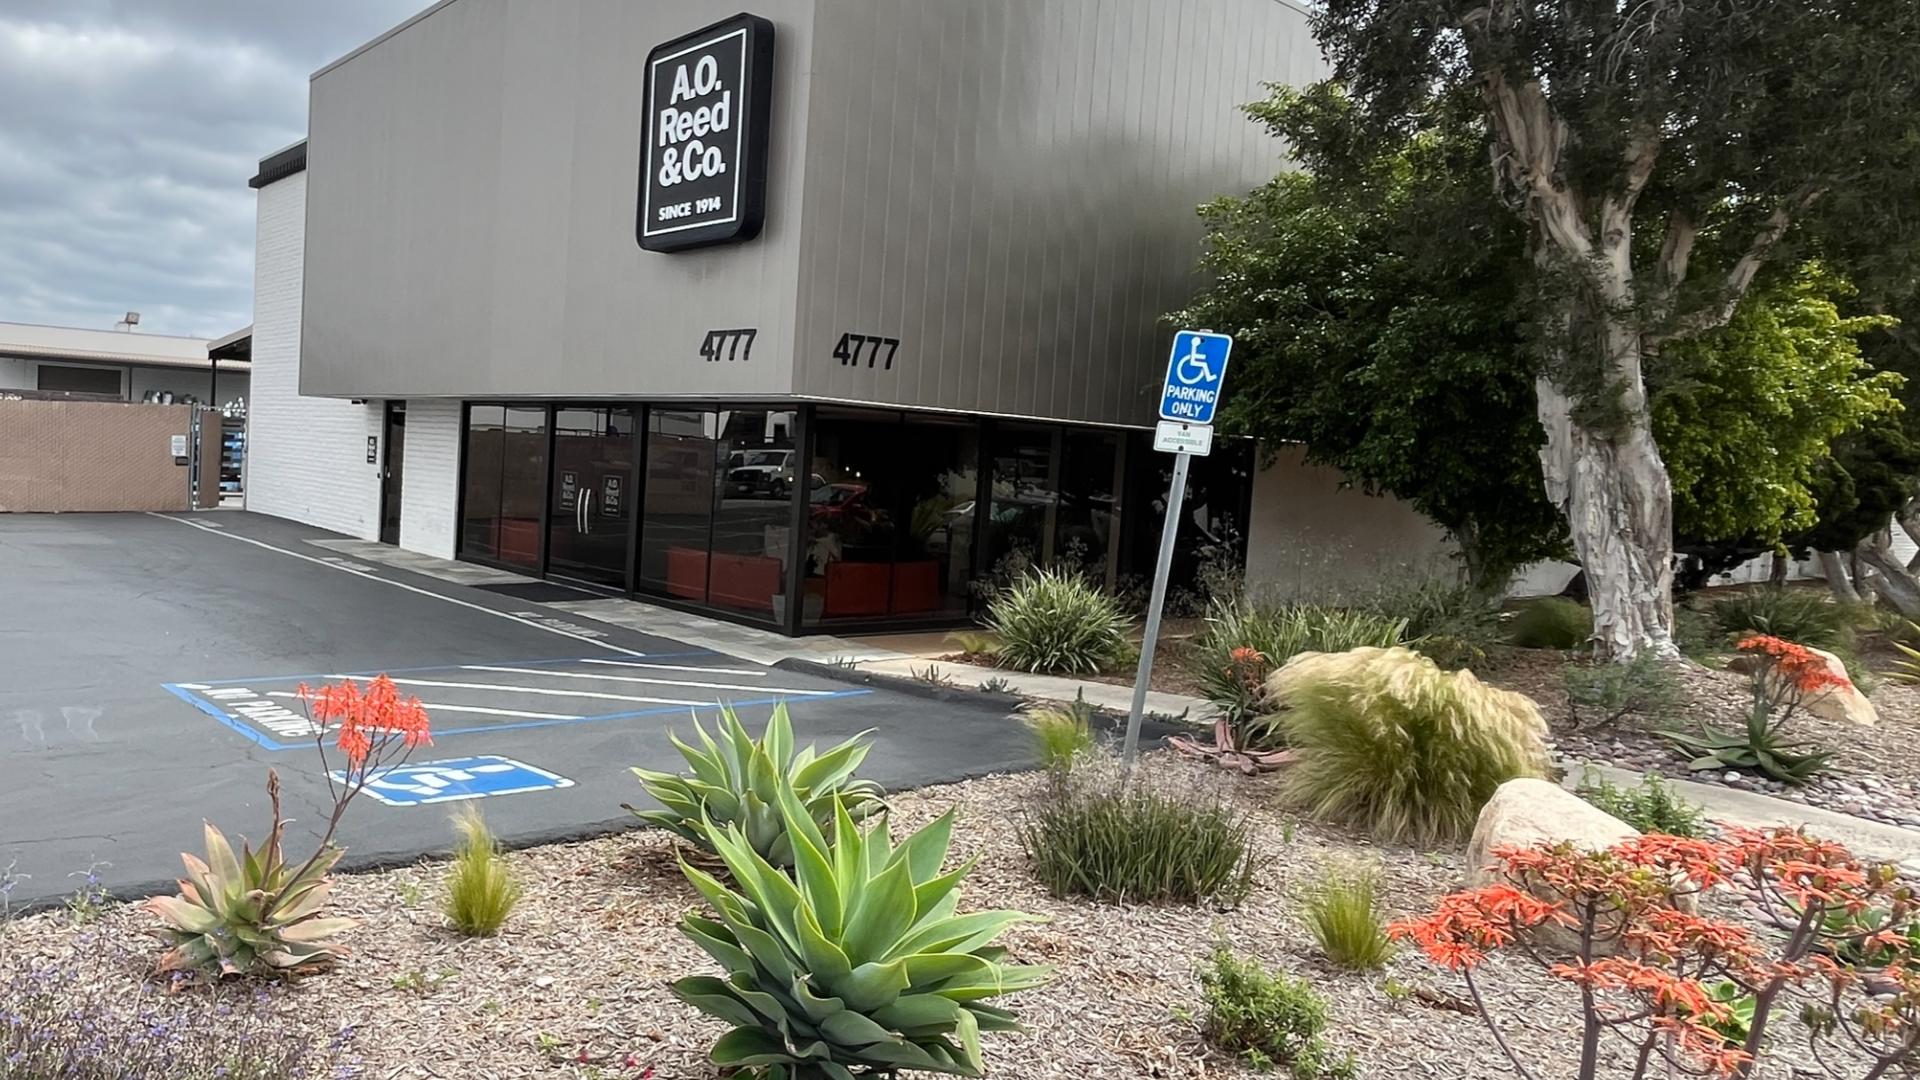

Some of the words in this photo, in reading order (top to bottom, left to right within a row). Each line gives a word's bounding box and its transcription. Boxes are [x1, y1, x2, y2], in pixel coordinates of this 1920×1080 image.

[671, 55, 722, 105] A.O.
[659, 91, 731, 147] Reed
[658, 140, 726, 187] &Co.
[658, 203, 692, 221] SINCE
[695, 196, 722, 214] 1914
[700, 328, 757, 361] 4777
[833, 333, 900, 370] 4777
[1166, 385, 1215, 403] PARKING
[1171, 401, 1203, 418] ONLY
